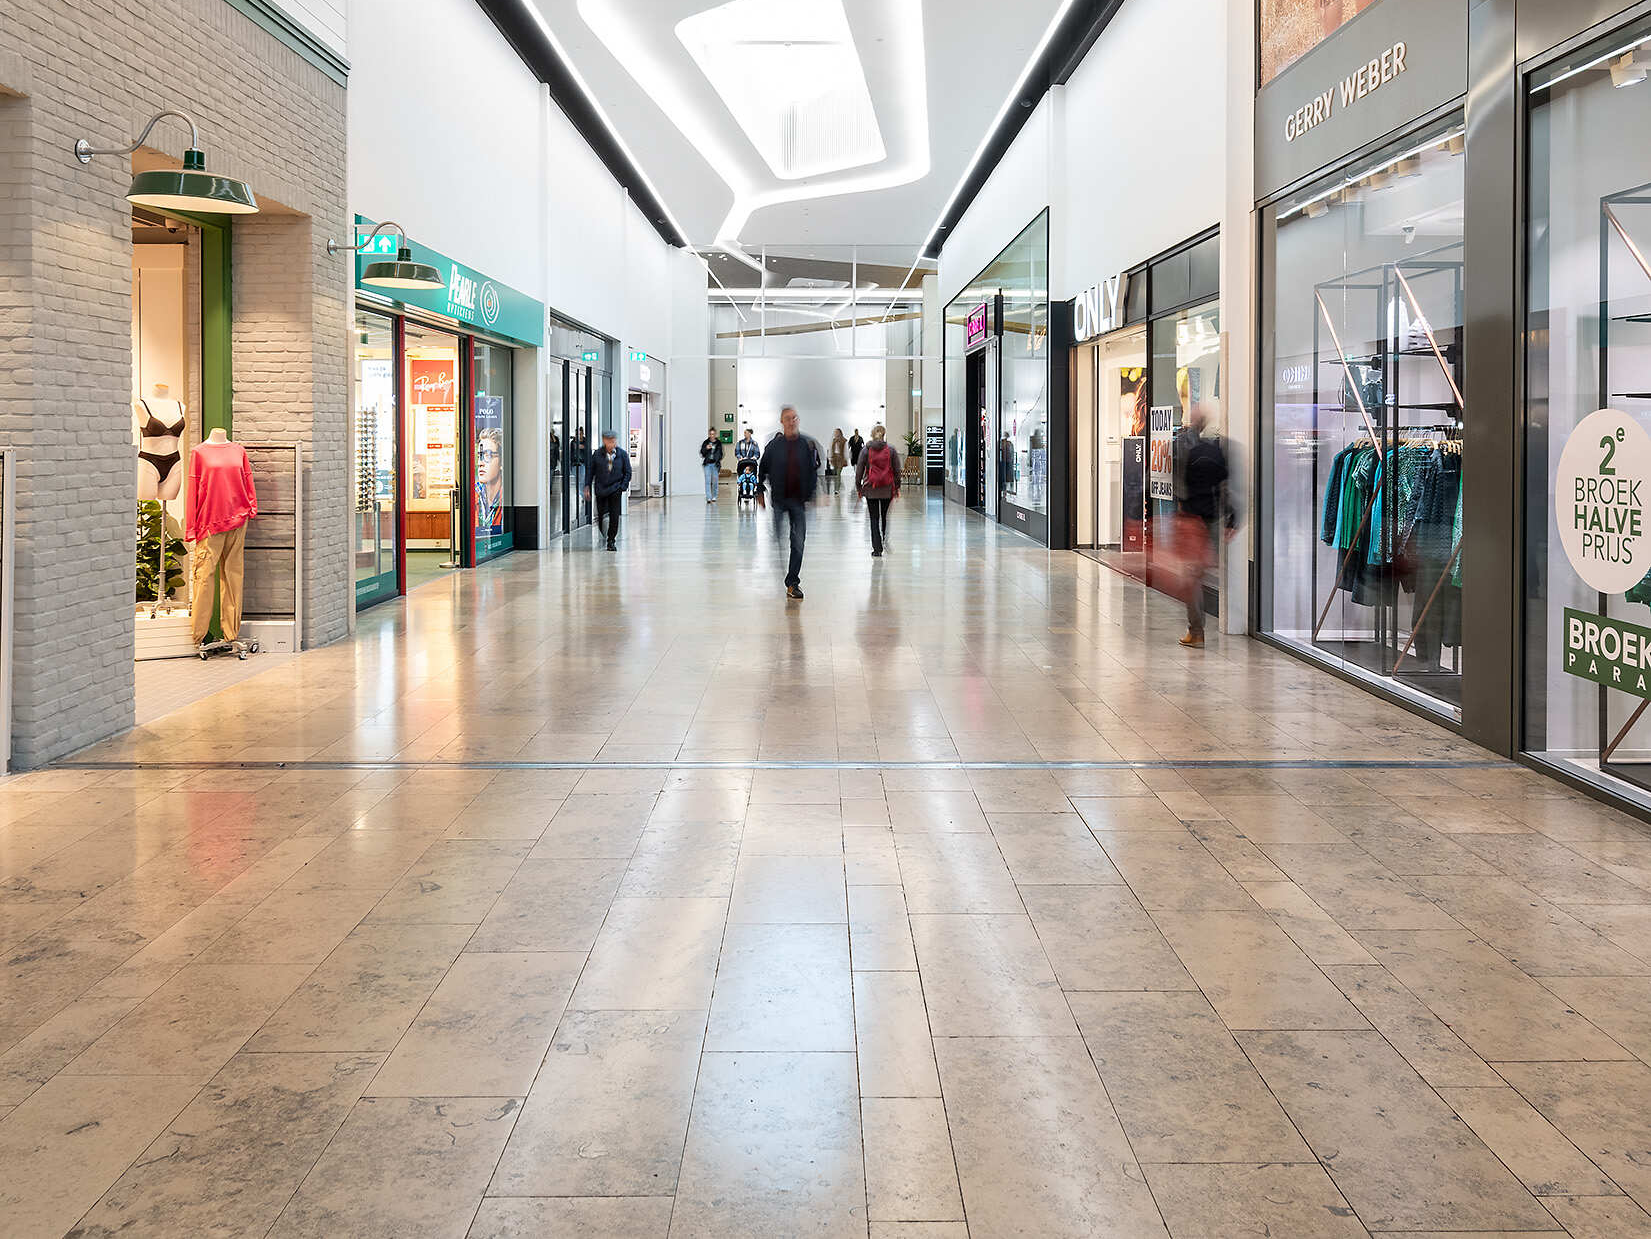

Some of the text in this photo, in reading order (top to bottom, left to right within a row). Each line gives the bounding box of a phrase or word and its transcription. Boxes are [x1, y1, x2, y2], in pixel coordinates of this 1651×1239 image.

[1285, 42, 1407, 142] GERRY WEBER
[448, 263, 477, 310] PEARLE
[1074, 273, 1122, 342] ONLY
[1151, 410, 1172, 432] TODAY
[1151, 439, 1172, 474] 20%
[1158, 481, 1172, 497] JEANS
[1574, 477, 1642, 507] BROEK
[1574, 504, 1642, 537] HALVE
[1569, 617, 1651, 670] BROEK
